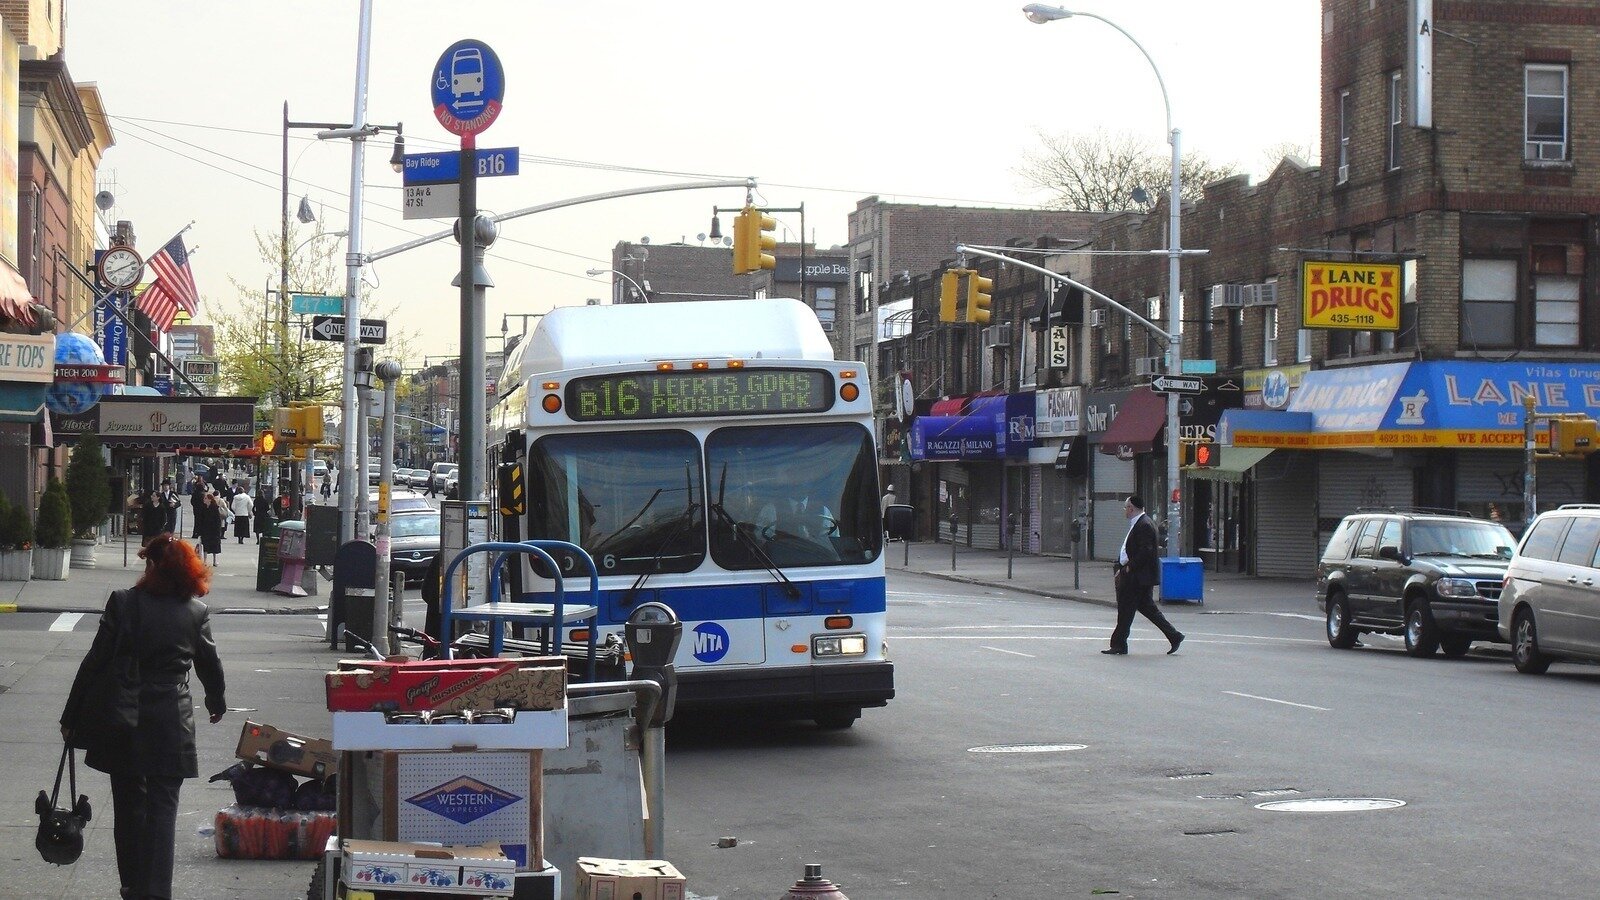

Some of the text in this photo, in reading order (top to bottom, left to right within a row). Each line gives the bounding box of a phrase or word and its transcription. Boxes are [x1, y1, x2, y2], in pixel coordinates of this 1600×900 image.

[440, 105, 496, 131] NO STANDING
[405, 157, 440, 169] Bay Ridge
[478, 153, 505, 175] B16
[405, 187, 431, 197] 13 Av &
[405, 198, 424, 207] 47 St
[1328, 269, 1377, 285] LANE
[301, 298, 321, 312] 47
[1310, 285, 1395, 320] DRUGS
[1330, 313, 1375, 324] 435-1118
[324, 323, 382, 336] ONE WAY
[17, 344, 45, 368] TOPS
[60, 368, 79, 377] TECH
[81, 368, 98, 377] 2000
[1526, 367, 1561, 377] Vilas
[1159, 379, 1198, 389] ONE WAY
[1444, 374, 1569, 407] LANE
[580, 379, 640, 416] B16
[651, 392, 811, 414] PROSPECT PK
[1047, 390, 1079, 418] FASHION
[1087, 405, 1108, 432] Silver
[61, 419, 95, 431] Hotel
[168, 421, 197, 432] Plaza
[202, 422, 250, 433] Restaurant
[927, 440, 993, 450] RAGAZZI MILANO
[1457, 433, 1476, 443] WE
[1480, 433, 1524, 443] ACCEPT
[692, 631, 723, 655] MTA
[431, 672, 483, 703] MUSHROOMS
[436, 793, 493, 805] WESTERN
